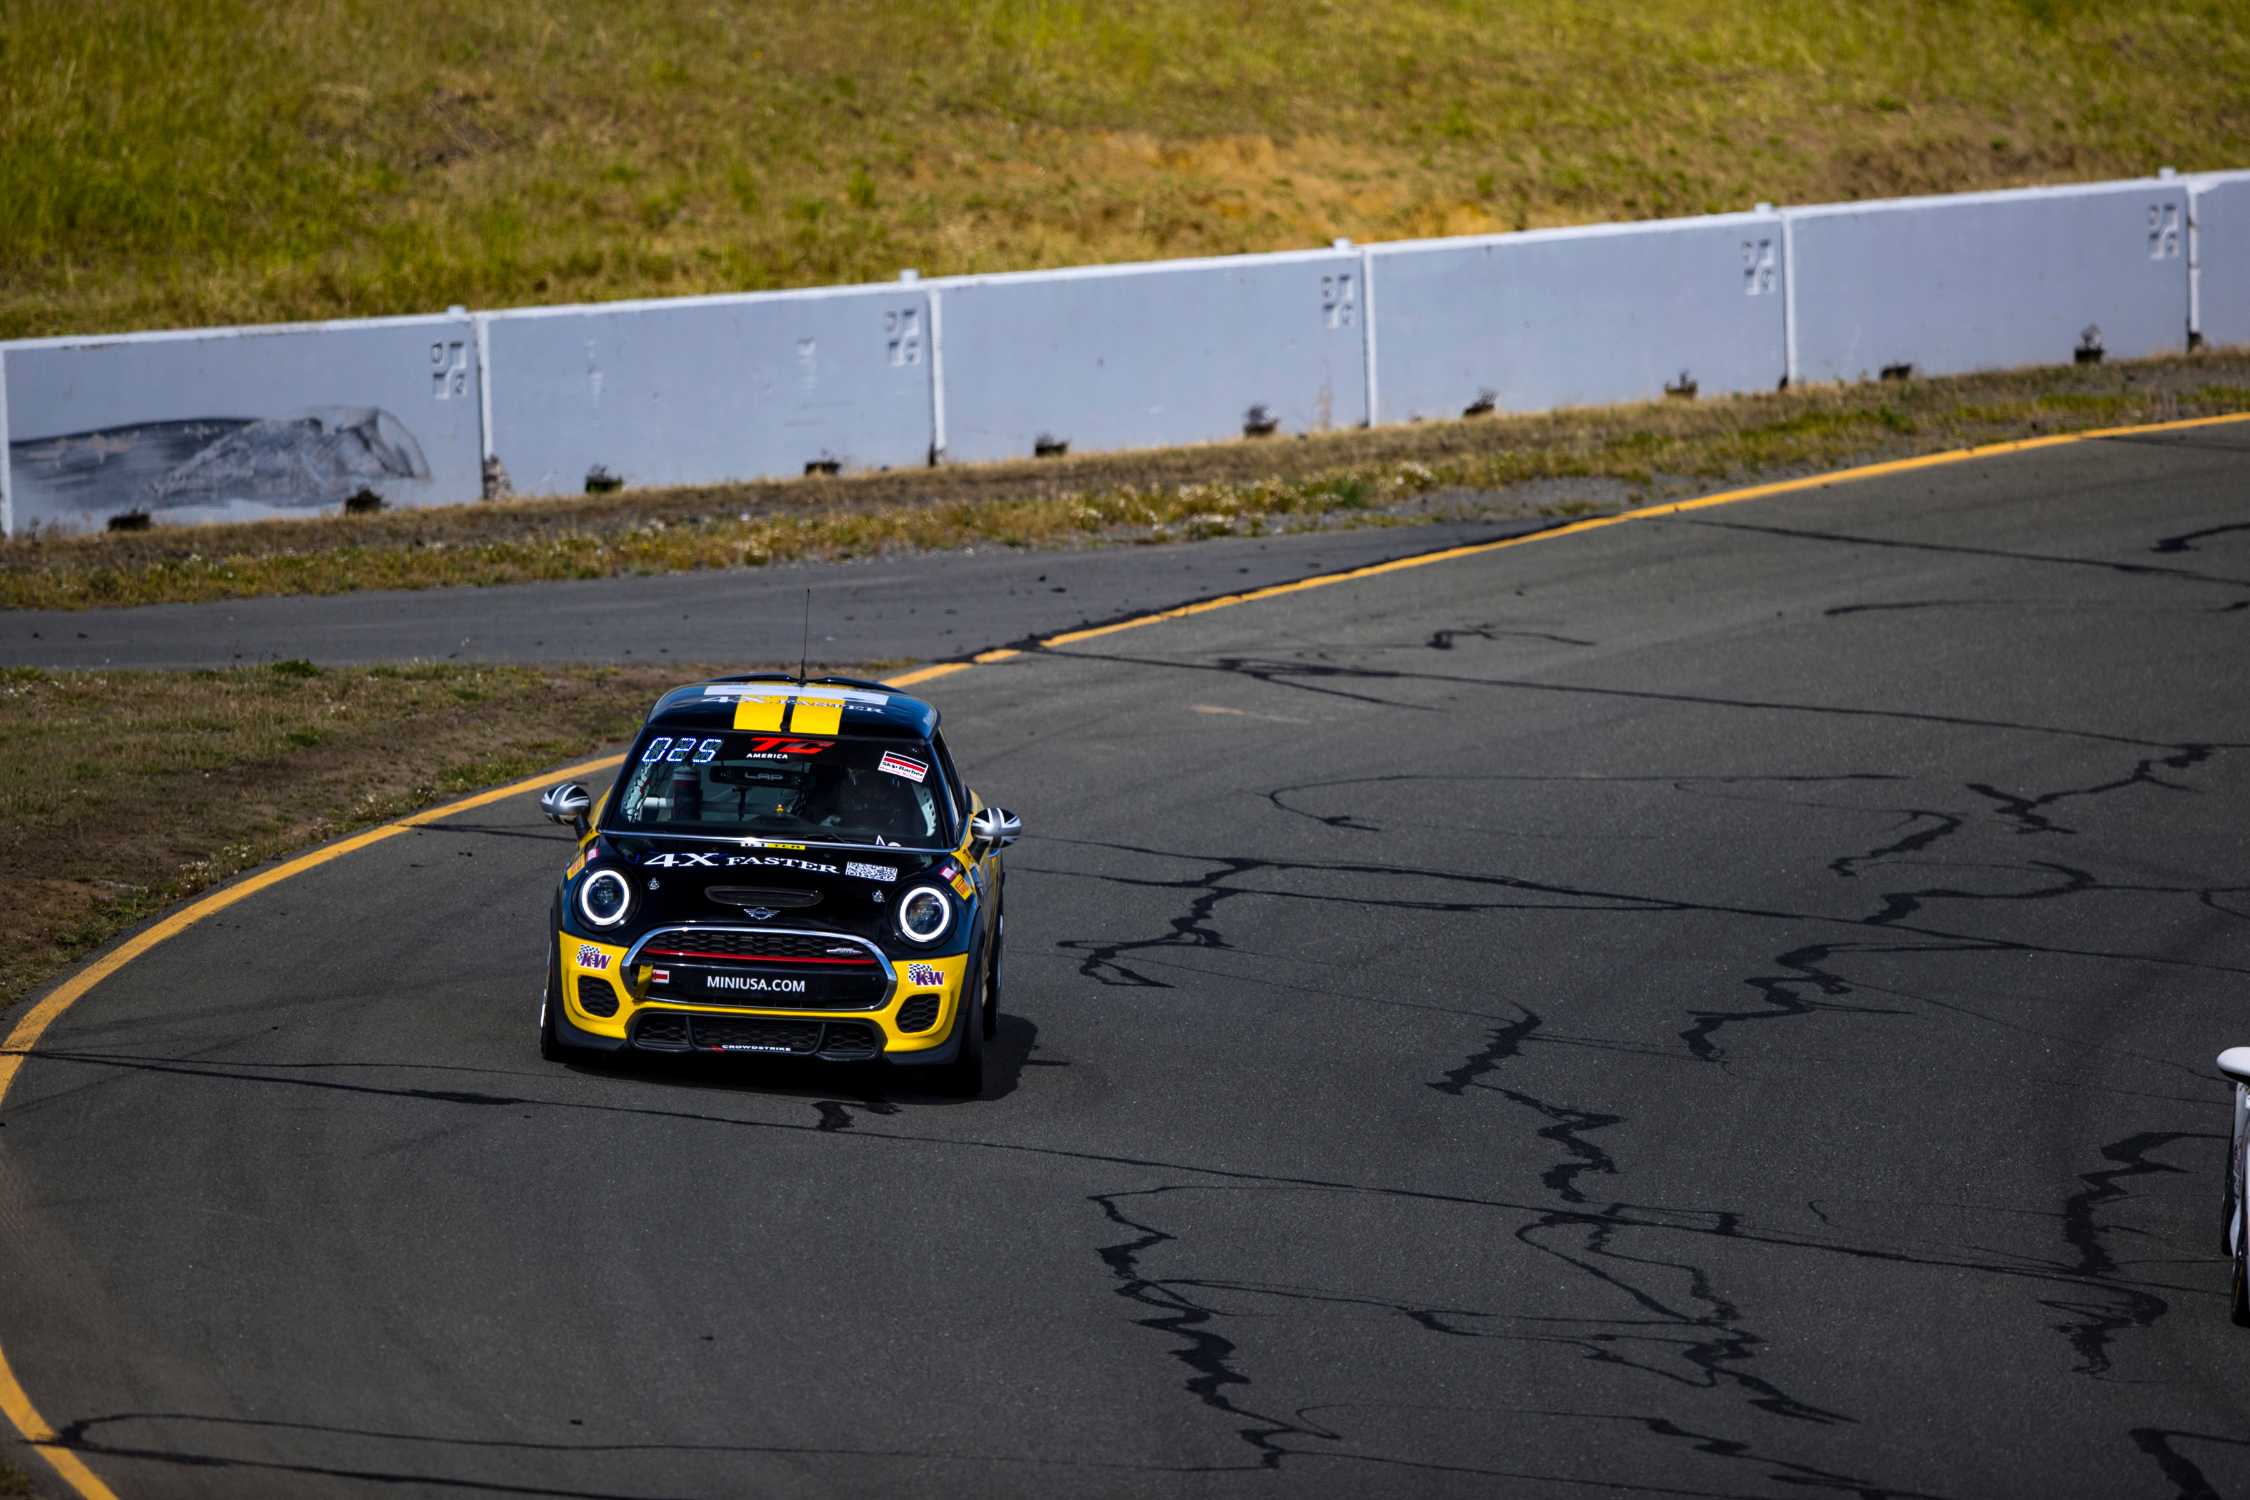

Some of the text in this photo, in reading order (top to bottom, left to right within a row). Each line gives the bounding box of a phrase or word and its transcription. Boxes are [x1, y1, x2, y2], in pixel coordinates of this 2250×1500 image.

[641, 737, 722, 763] 025
[750, 736, 836, 755] TC
[745, 752, 789, 760] AMERICA
[643, 852, 840, 874] 4X FASTER
[579, 952, 612, 970] KW
[706, 975, 806, 993] MINIUSA.COM
[914, 969, 945, 987] KW
[721, 1044, 792, 1052] CROWDSTRIKE
